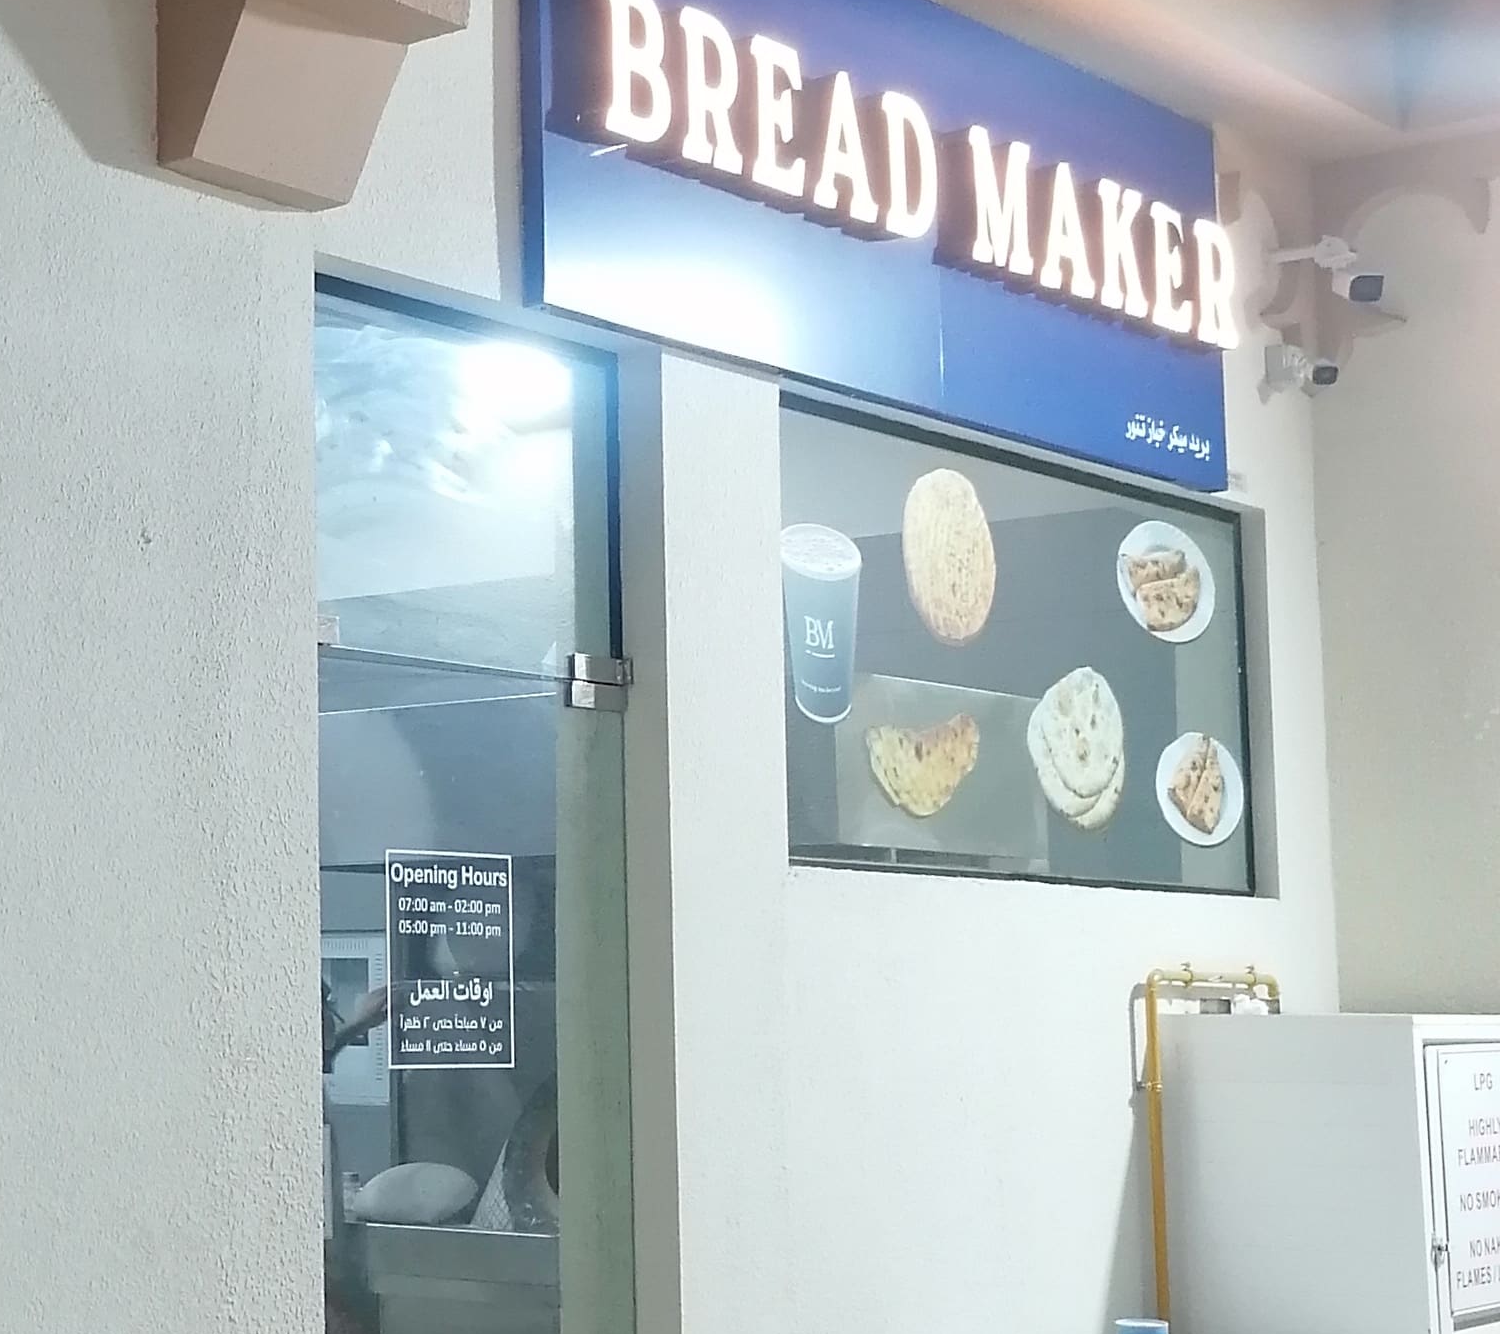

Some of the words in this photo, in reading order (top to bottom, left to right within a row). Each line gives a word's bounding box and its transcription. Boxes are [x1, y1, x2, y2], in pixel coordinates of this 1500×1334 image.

[968, 124, 1239, 350] MAKER
[1167, 425, 1187, 453] ميكر
[1189, 433, 1210, 461] بريد
[804, 615, 835, 649] BM
[390, 863, 458, 889] Opening
[461, 865, 507, 887] Hours
[398, 897, 428, 912] 07:00
[430, 901, 446, 912] am
[454, 899, 483, 913] 02:00
[485, 903, 501, 917] pm
[398, 920, 428, 934] 05:00
[430, 923, 447, 937] pm
[456, 921, 483, 935] 11:00
[485, 925, 501, 939] pm
[410, 979, 449, 1006] العمل
[489, 1019, 503, 1032] من
[489, 1043, 502, 1055] من
[1474, 1072, 1493, 1090] LPG
[1458, 1144, 1500, 1166] FLAMMA
[1460, 1193, 1474, 1211] NO
[1469, 1239, 1482, 1258] NO
[1457, 1266, 1492, 1289] FLAMES
